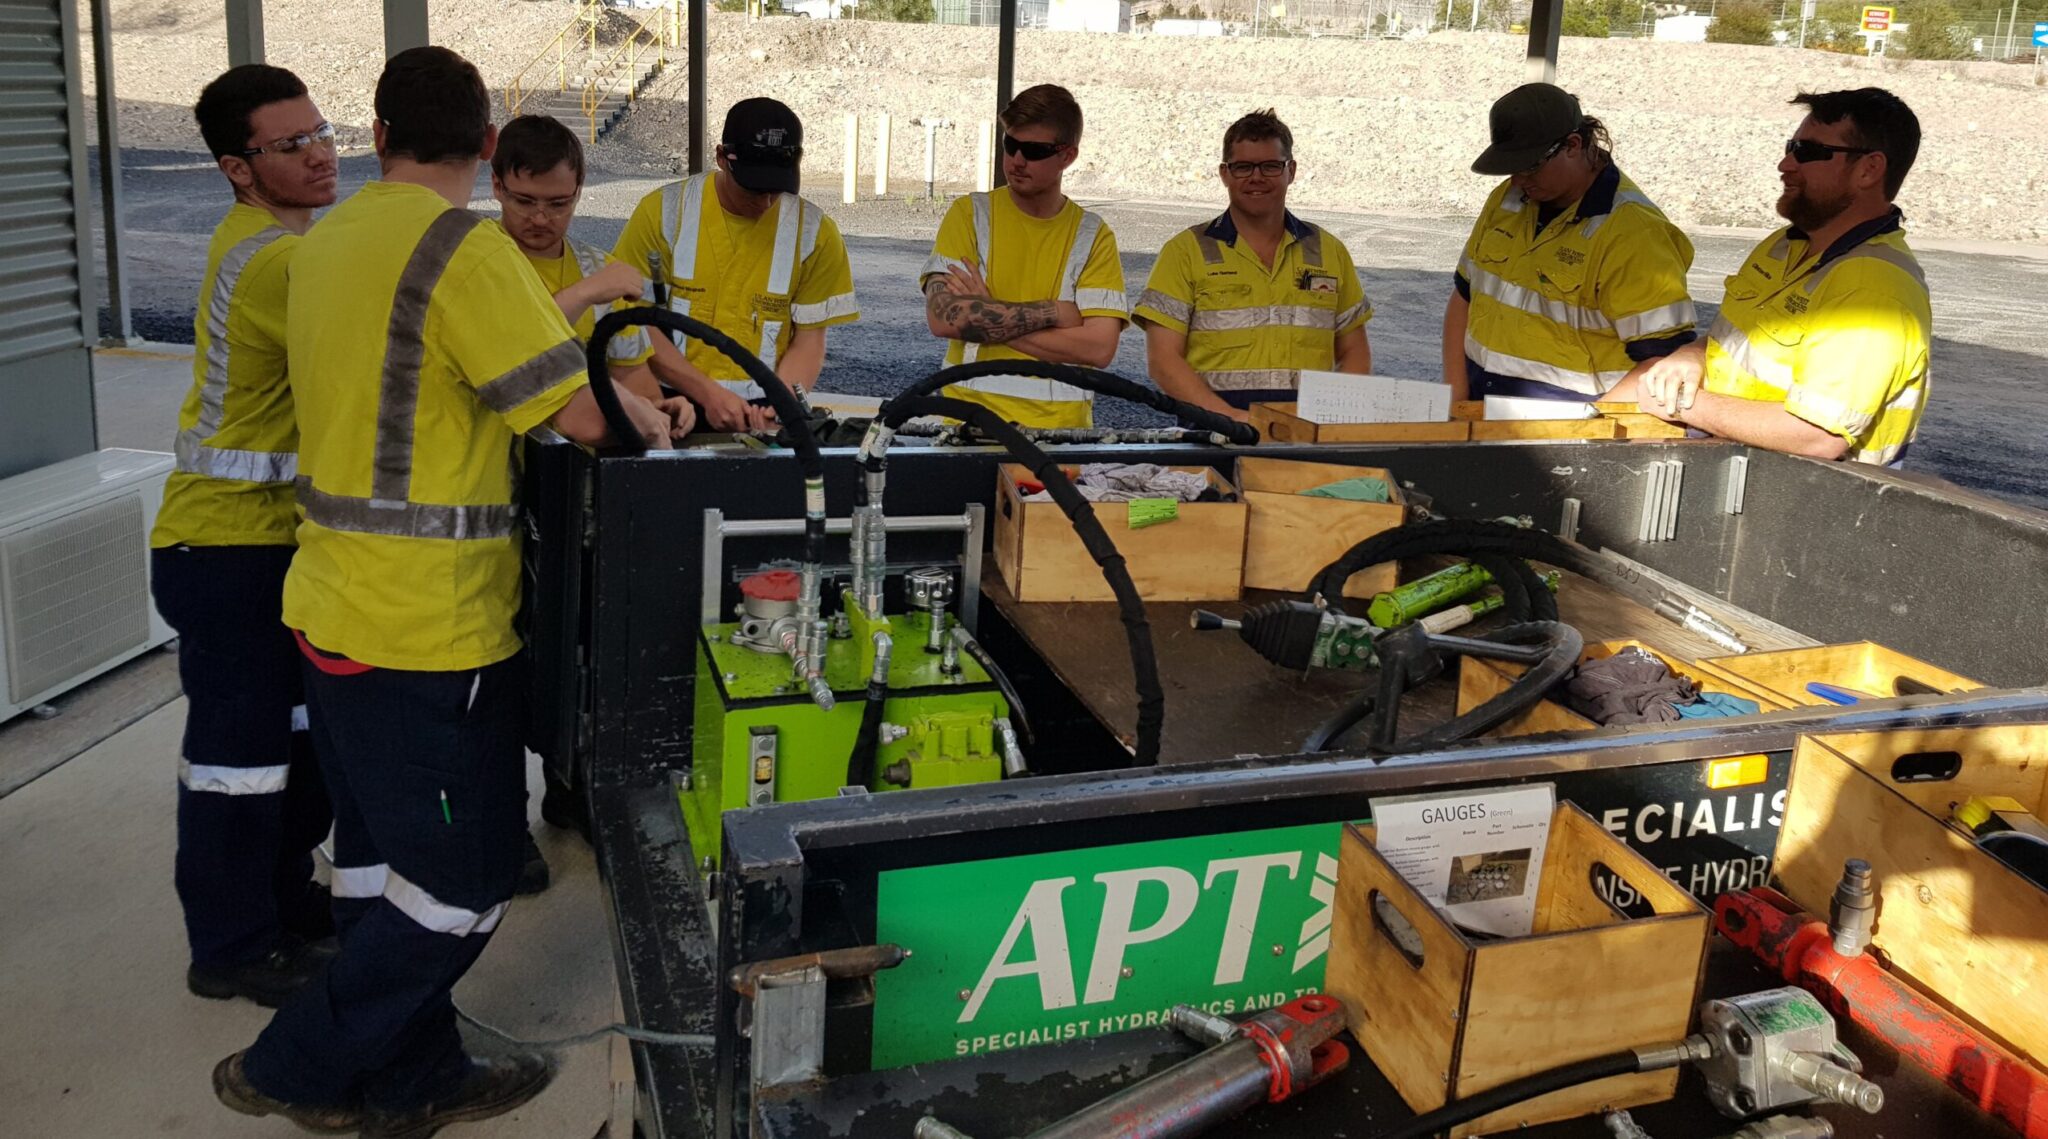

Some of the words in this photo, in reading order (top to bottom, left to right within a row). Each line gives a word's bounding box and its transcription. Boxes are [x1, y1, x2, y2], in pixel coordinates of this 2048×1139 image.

[1421, 803, 1486, 824] GAUGES
[1490, 808, 1513, 818] (Green)
[1602, 789, 1787, 844] ECIALIS
[1405, 834, 1432, 842] Description
[1688, 855, 1774, 897] HYDR
[956, 850, 1303, 1024] APT
[956, 1020, 1090, 1056] SPECIALIST
[1099, 999, 1235, 1034] HYDRAICS
[1243, 991, 1286, 1012] AND
